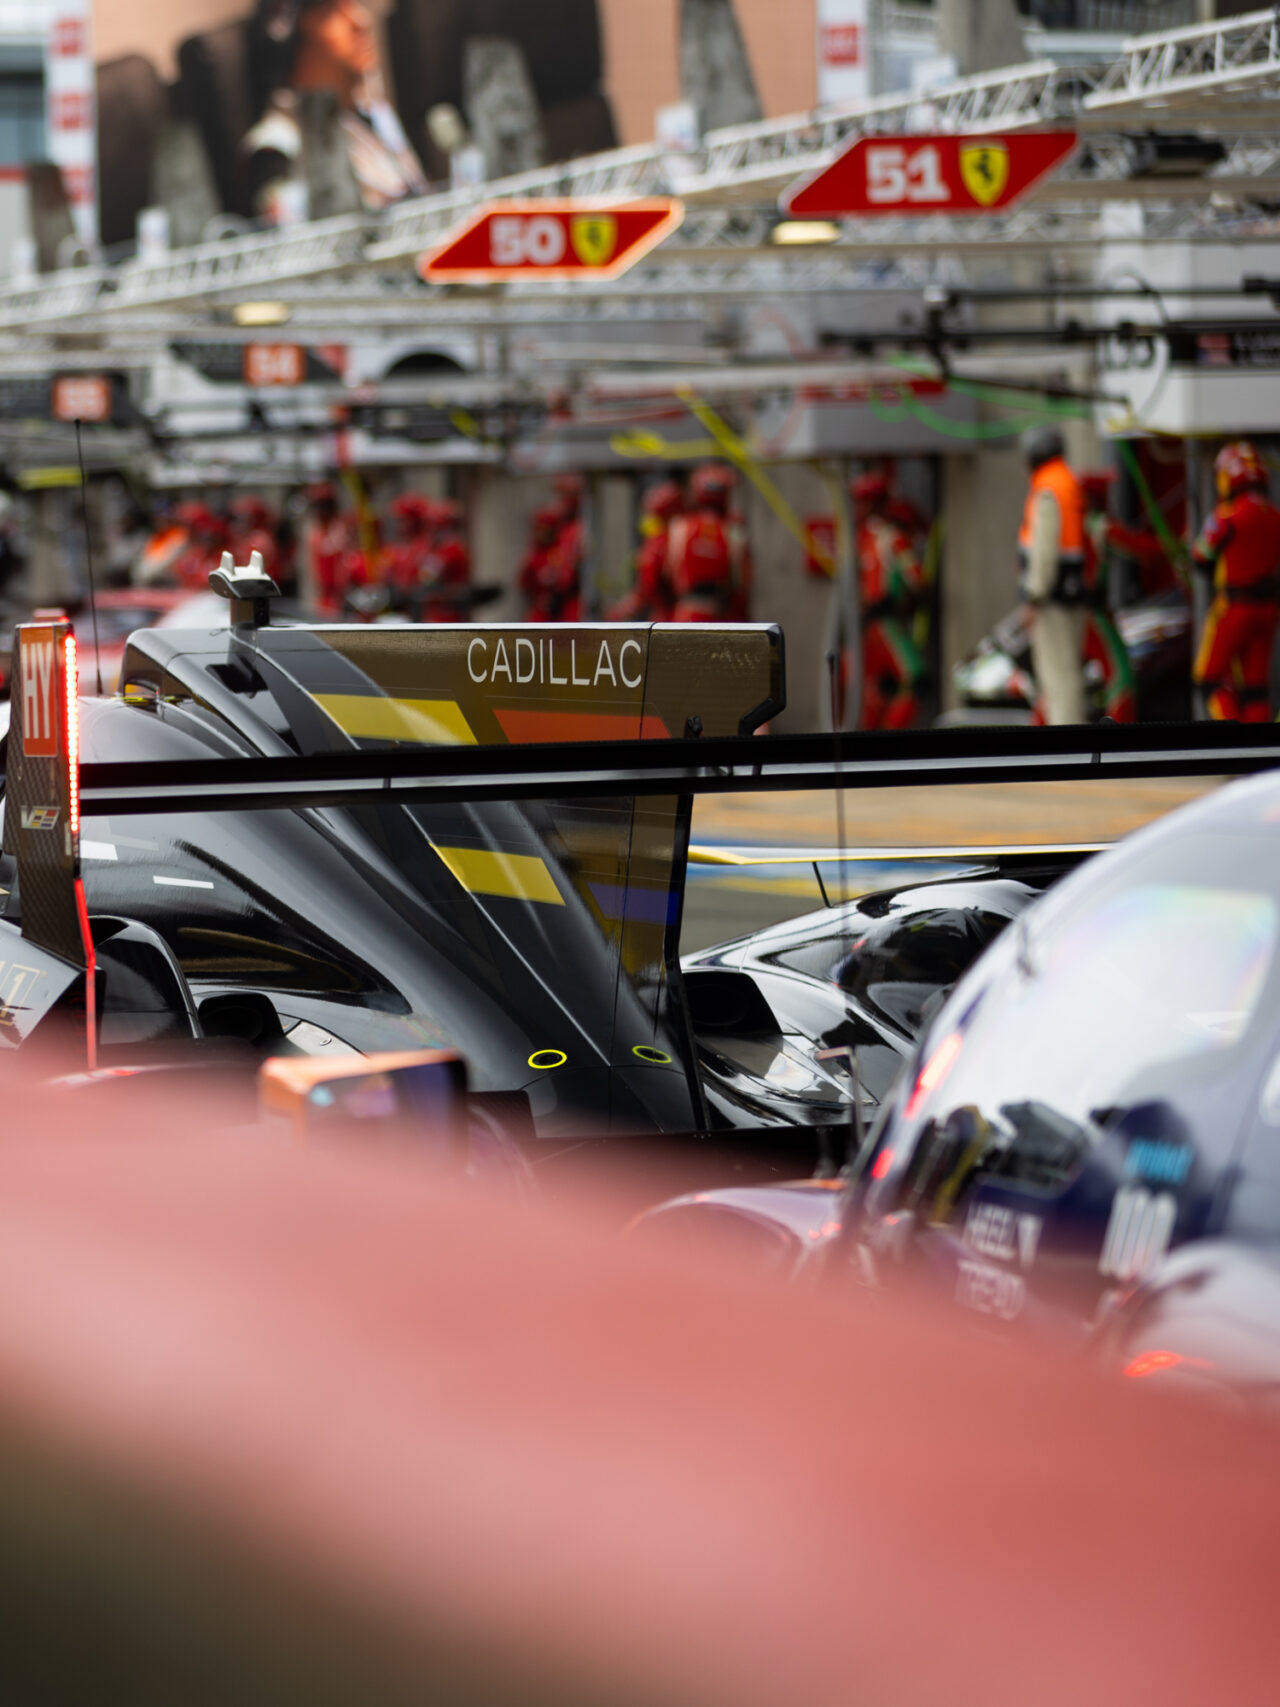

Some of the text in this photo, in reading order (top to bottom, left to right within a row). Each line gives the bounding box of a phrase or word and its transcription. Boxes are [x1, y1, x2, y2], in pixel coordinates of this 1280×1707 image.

[866, 144, 951, 203] 51
[489, 214, 566, 266] 50
[467, 637, 642, 688] CADILLAC
[22, 642, 53, 740] HY
